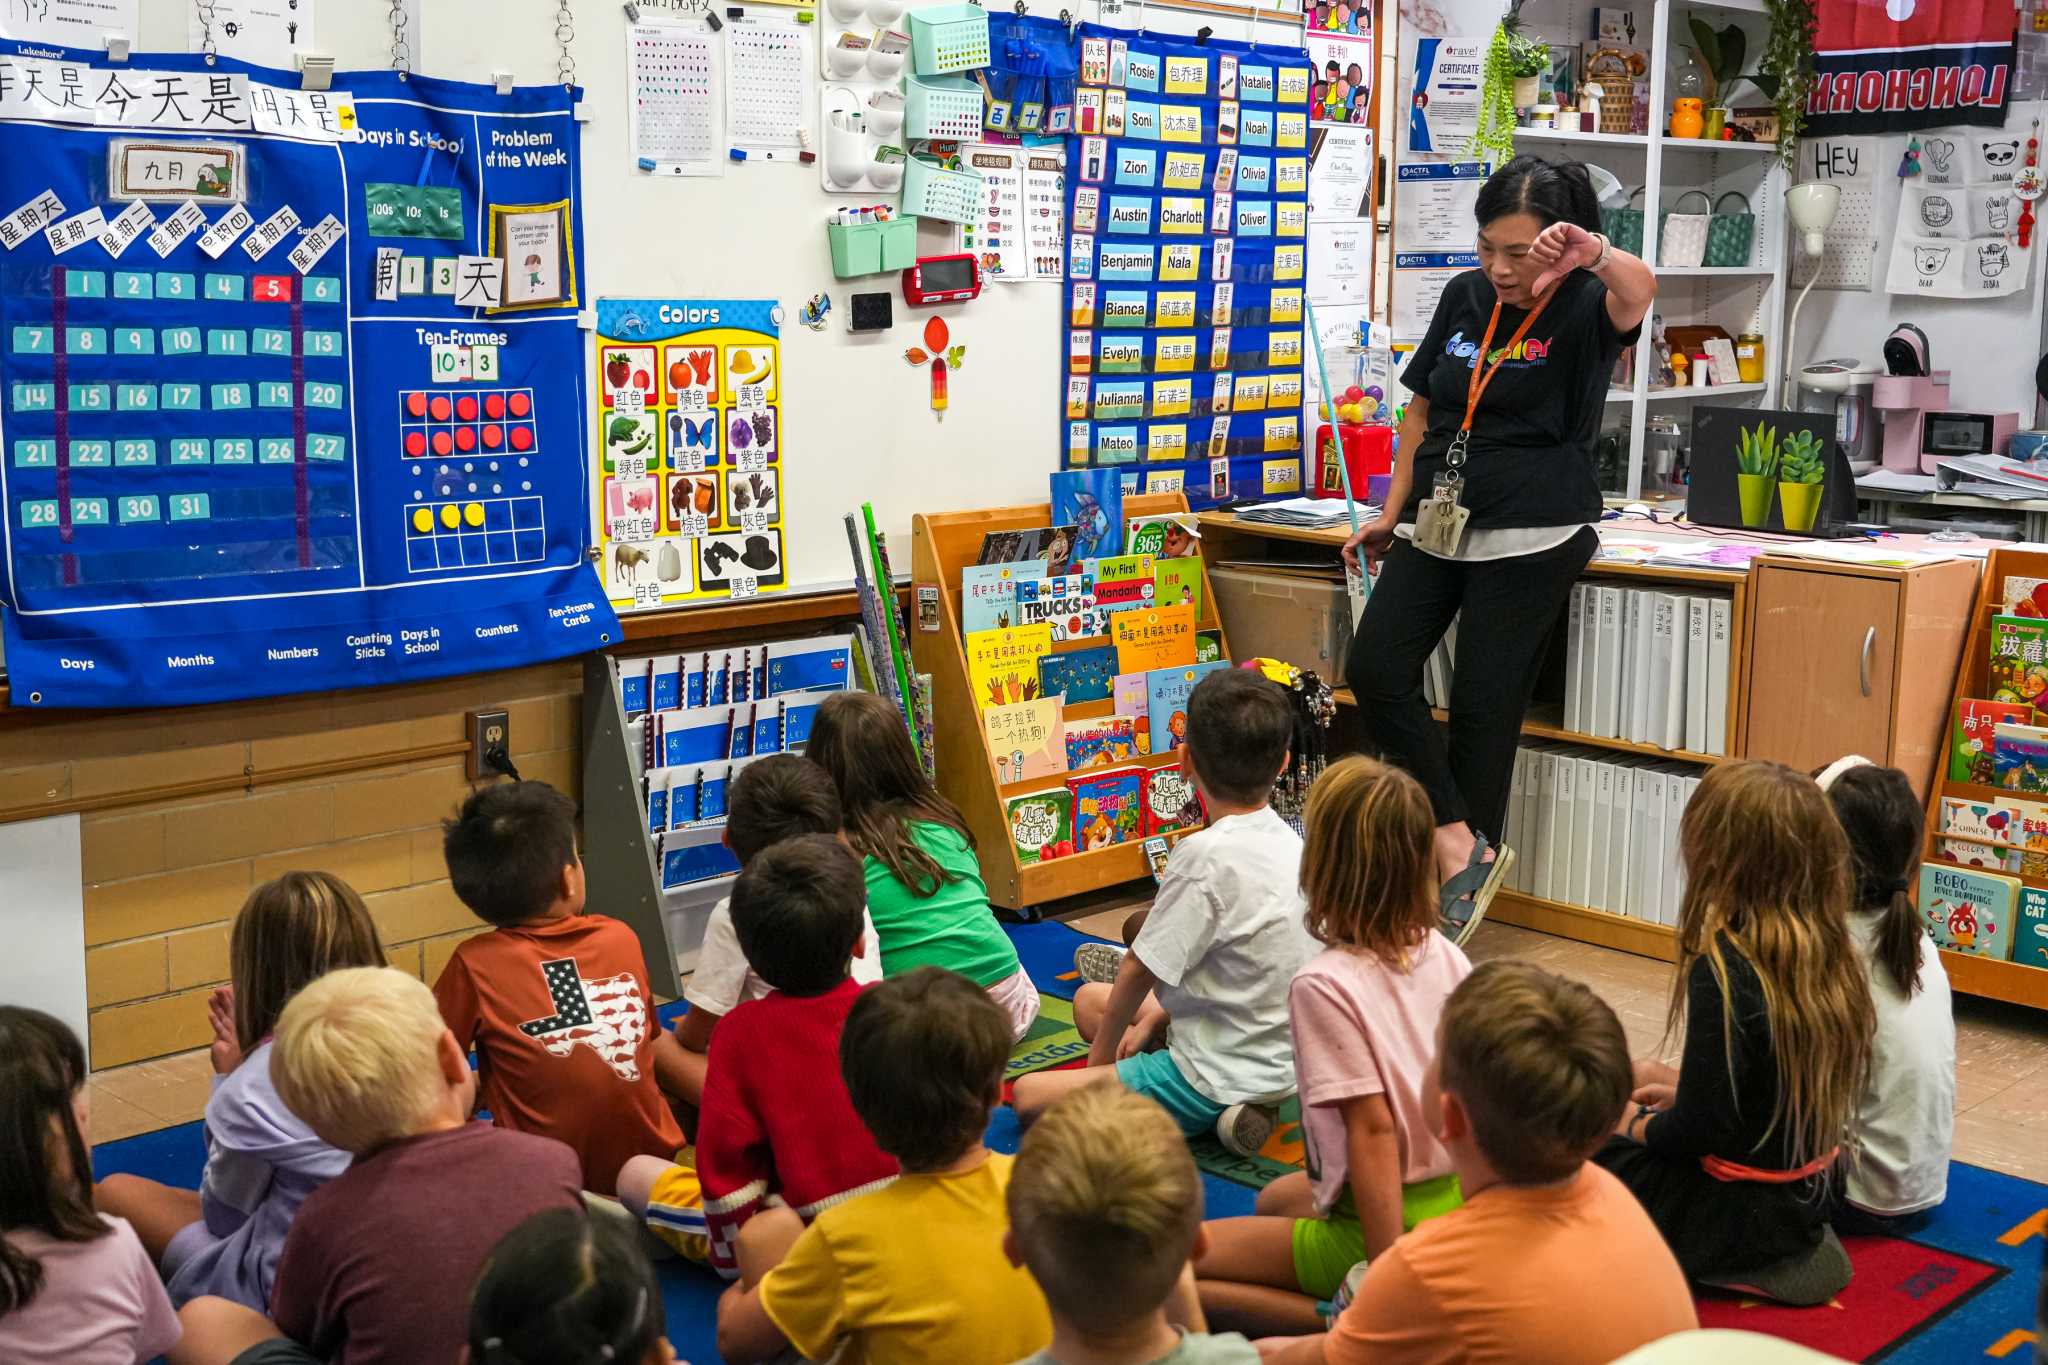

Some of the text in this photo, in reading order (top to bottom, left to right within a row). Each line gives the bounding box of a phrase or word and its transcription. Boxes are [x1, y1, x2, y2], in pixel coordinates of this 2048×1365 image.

[17, 45, 62, 59] Lakeshore
[1085, 43, 1106, 58] 队长
[1129, 62, 1155, 80] Rosie
[1169, 66, 1203, 83] 包乔理
[1439, 64, 1480, 75] CERTIFICATE
[1240, 75, 1272, 90] Natalie
[96, 72, 247, 125] 今天是
[1078, 93, 1100, 107] 扶门
[252, 88, 345, 136] 明天是
[992, 108, 1005, 125] 百
[1025, 109, 1038, 126] 十
[1132, 113, 1152, 128] Soni
[1164, 115, 1197, 132] 沈杰星
[1245, 121, 1268, 135] Noah
[356, 129, 405, 150] Days in
[492, 130, 553, 147] Problem
[486, 148, 567, 168] of the Week
[1815, 142, 1859, 179] HEY
[143, 160, 184, 182] 九月
[1124, 160, 1148, 174] Zion
[1241, 167, 1266, 180] Olivia
[1409, 167, 1431, 175] ACTFL
[1992, 173, 2013, 182] PANDA
[1077, 192, 1097, 206] 月历
[373, 203, 394, 216] 100s
[406, 206, 422, 218] 10s
[439, 205, 449, 219] 1s
[1112, 207, 1148, 223] Austin
[1162, 208, 1202, 224] Charlott
[0, 196, 63, 245] 星期天
[1239, 212, 1267, 226] Oliver
[50, 218, 101, 251] 星期一
[104, 206, 151, 254] 星期二
[152, 207, 202, 255] 星期三
[246, 209, 298, 258] 星期五
[292, 220, 342, 270] 星期六
[1073, 238, 1091, 250] 天气
[1101, 253, 1153, 271] Benjamin
[1167, 255, 1191, 269] Nala
[1406, 256, 1428, 264] ACTFL
[377, 250, 499, 302] 第 1 3 天
[82, 275, 327, 297] 1 2 3 4 5 6
[1075, 286, 1093, 298] 铅笔
[658, 304, 721, 325] Colors
[1106, 302, 1145, 316] Bianca
[29, 331, 333, 351] 7 8 9 10 11 12 13
[415, 328, 508, 346] Ten-Frames
[1103, 345, 1140, 361] Evelyn
[437, 352, 490, 373] 10 + 3
[740, 386, 765, 401] 黄色
[1071, 381, 1087, 393] 剪刀
[25, 385, 335, 407] 14 15 16 17 18 19 20
[616, 390, 642, 406] 红色
[680, 390, 704, 406] 橘色
[1097, 392, 1143, 407] Julianna
[1157, 388, 1191, 404] 石诺兰
[1071, 425, 1088, 437] 发纸
[26, 438, 337, 462] 21 22 23 24 25 26 27
[1101, 436, 1133, 450] Mateo
[677, 450, 702, 466] 蓝色
[740, 450, 765, 465] 紫色
[619, 459, 646, 475] 绿色
[1267, 468, 1297, 484] 罗安利
[1150, 479, 1180, 494] 郭飞明
[31, 498, 199, 523] 28 29 30 31
[613, 519, 653, 535] 粉红色
[681, 515, 706, 531] 棕色
[743, 513, 767, 528] 灰色
[1136, 534, 1162, 553] 365
[1103, 563, 1136, 577] My First
[635, 583, 660, 599] 白色
[732, 577, 757, 593] 黑色
[1097, 584, 1141, 599] Mandarin
[548, 601, 596, 619] Ten-Frame
[1024, 597, 1081, 619] TRUCKS
[562, 612, 592, 629] Cards
[401, 627, 440, 643] Days in
[475, 622, 519, 639] Counters
[346, 632, 393, 648] Counting
[404, 640, 440, 655] School
[267, 645, 319, 661] Numbers
[355, 646, 386, 660] Sticks
[60, 656, 95, 672] Days
[167, 653, 215, 670] Months
[1958, 824, 1989, 836] CHINESE
[1934, 871, 1968, 889] BOBO
[1953, 889, 1992, 906] DUMPLINGS
[2026, 893, 2046, 905] Who
[2025, 904, 2045, 919] CAT
